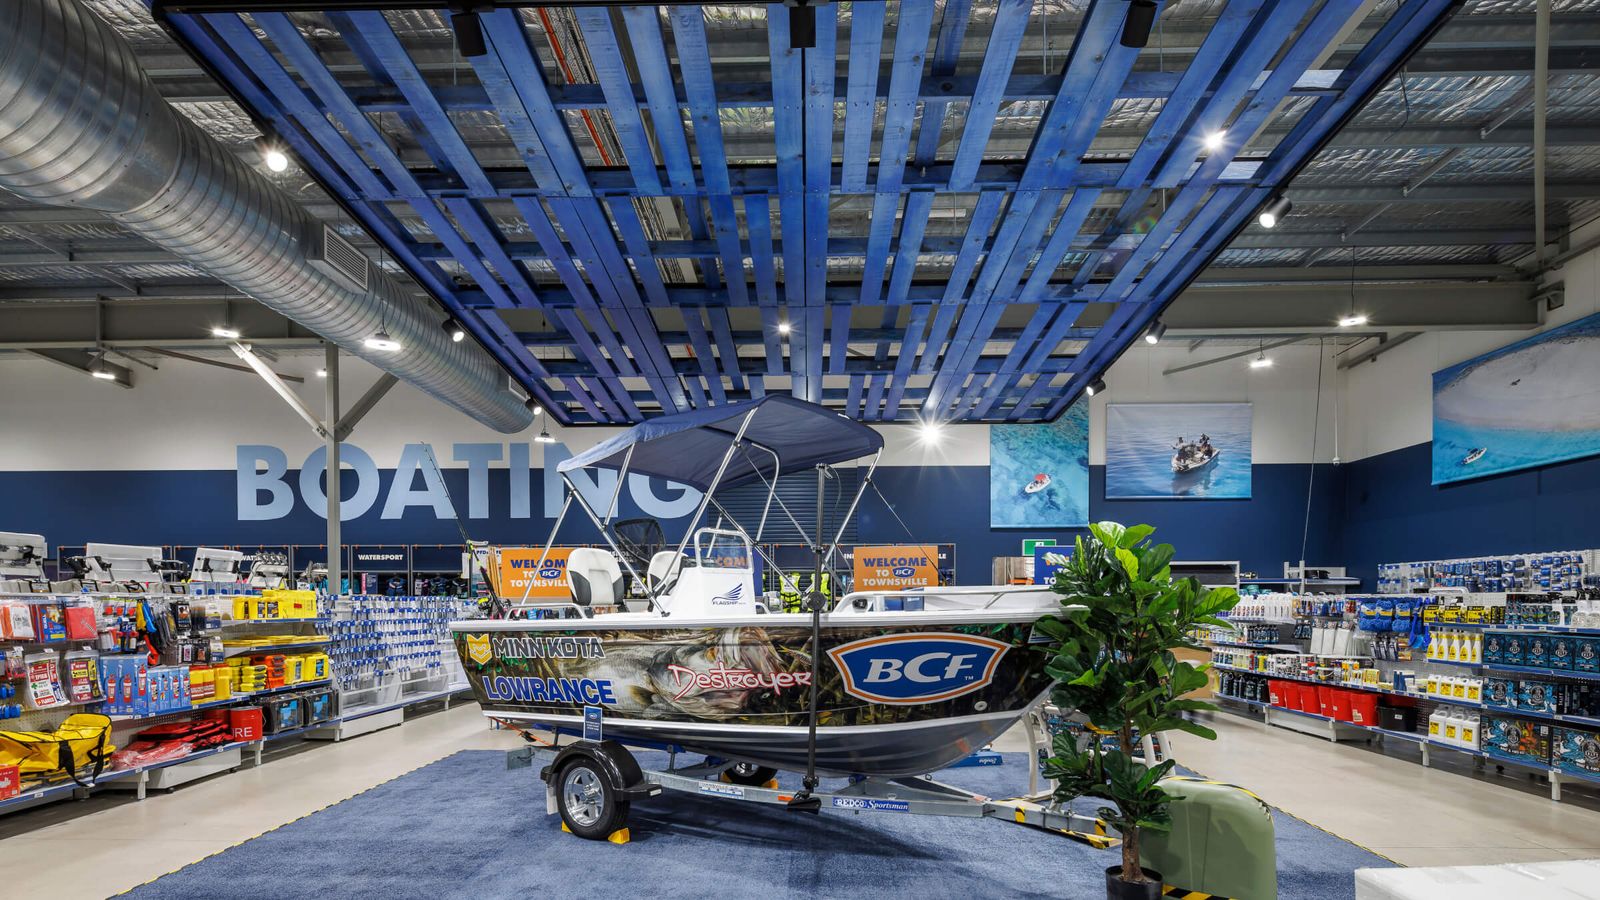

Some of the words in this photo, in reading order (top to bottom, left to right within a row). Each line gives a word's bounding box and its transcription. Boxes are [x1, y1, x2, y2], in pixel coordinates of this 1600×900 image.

[236, 442, 703, 521] BOATING
[863, 557, 927, 567] WELCOME
[876, 569, 890, 577] TO
[863, 578, 928, 587] TOWNSVILLE
[492, 637, 545, 659] MINN
[546, 637, 606, 659] KOTA
[863, 652, 977, 683] BCF
[482, 676, 617, 705] LOWRANCE
[837, 798, 865, 808] REDCO
[867, 800, 908, 810] Sportsman
